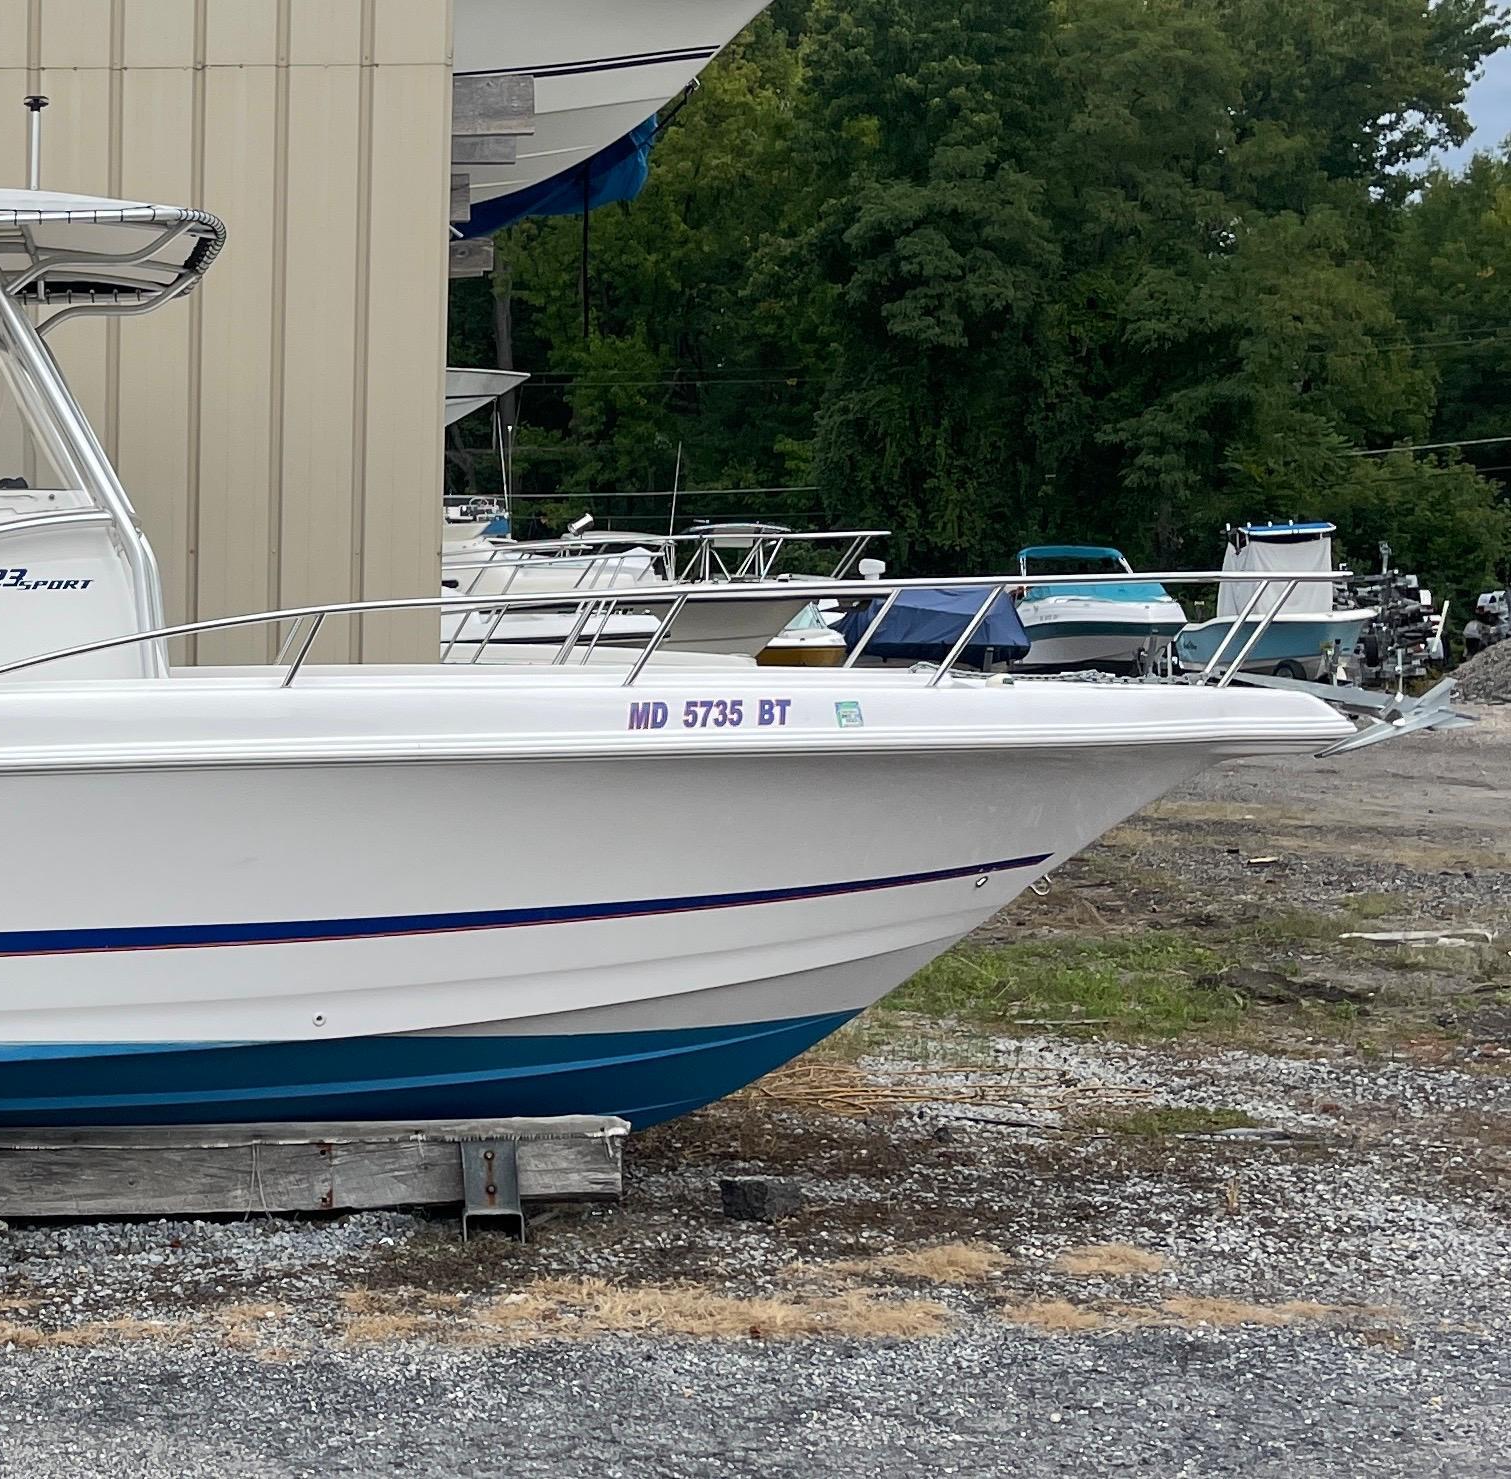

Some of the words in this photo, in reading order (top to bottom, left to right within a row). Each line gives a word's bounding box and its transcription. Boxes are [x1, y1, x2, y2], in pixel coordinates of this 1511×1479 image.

[17, 579, 95, 591] SPORT
[627, 701, 669, 730] MD
[682, 699, 743, 728] 5735
[757, 699, 792, 726] BT
